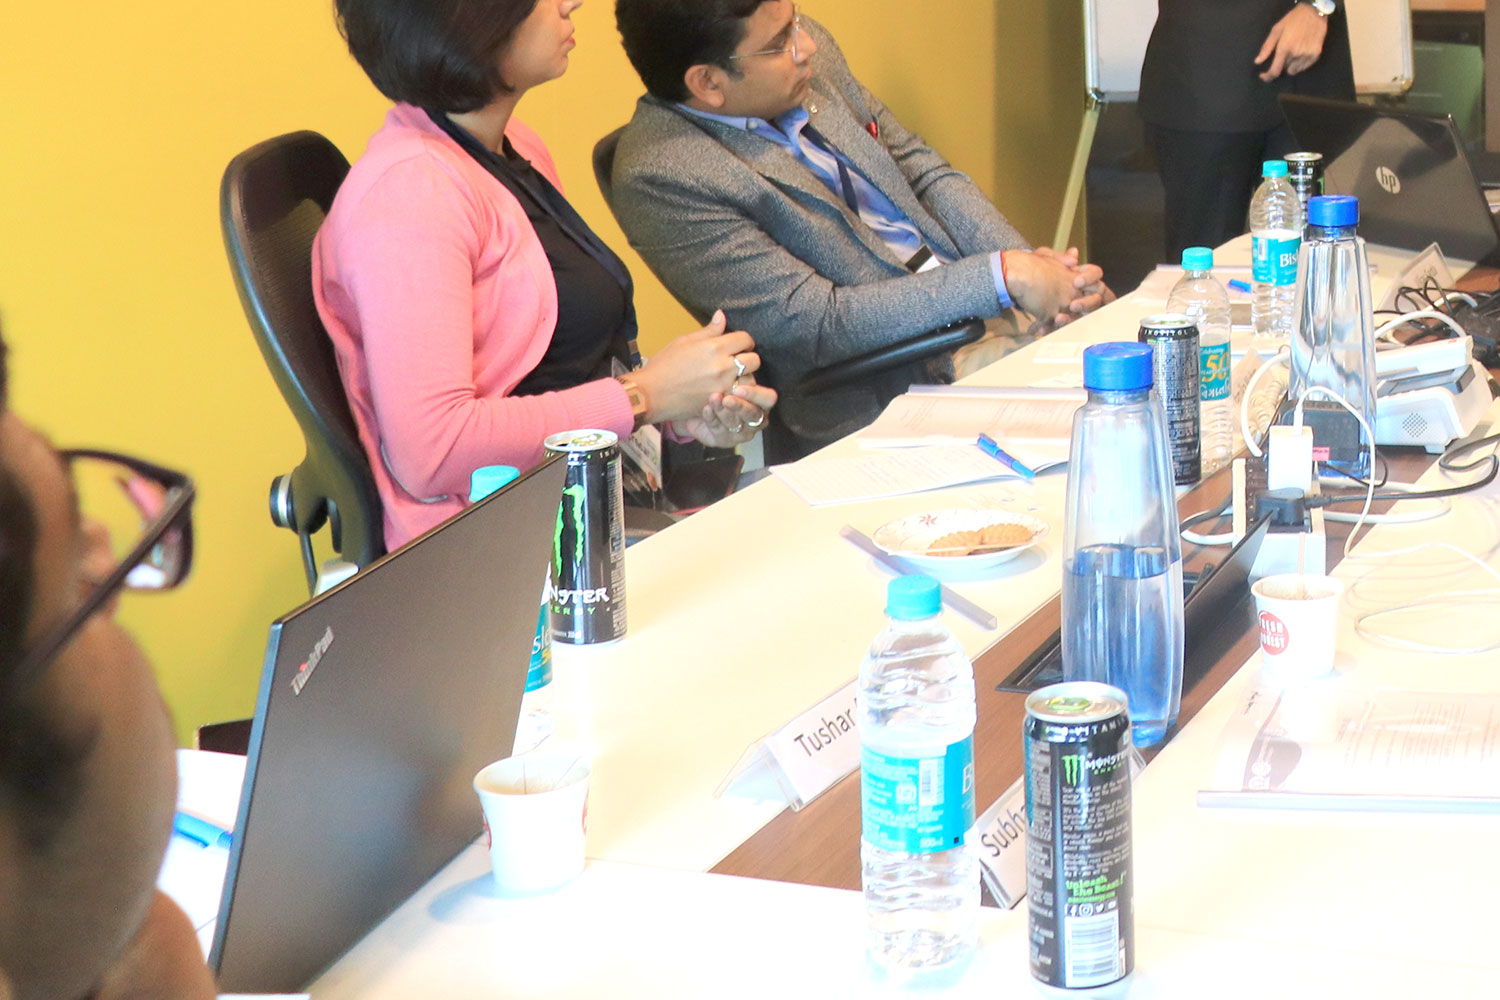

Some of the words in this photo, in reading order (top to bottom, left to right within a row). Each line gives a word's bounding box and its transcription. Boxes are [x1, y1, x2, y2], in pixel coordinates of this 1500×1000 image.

[1381, 165, 1396, 192] hp
[1280, 249, 1298, 267] Bis
[793, 708, 856, 757] Tushar
